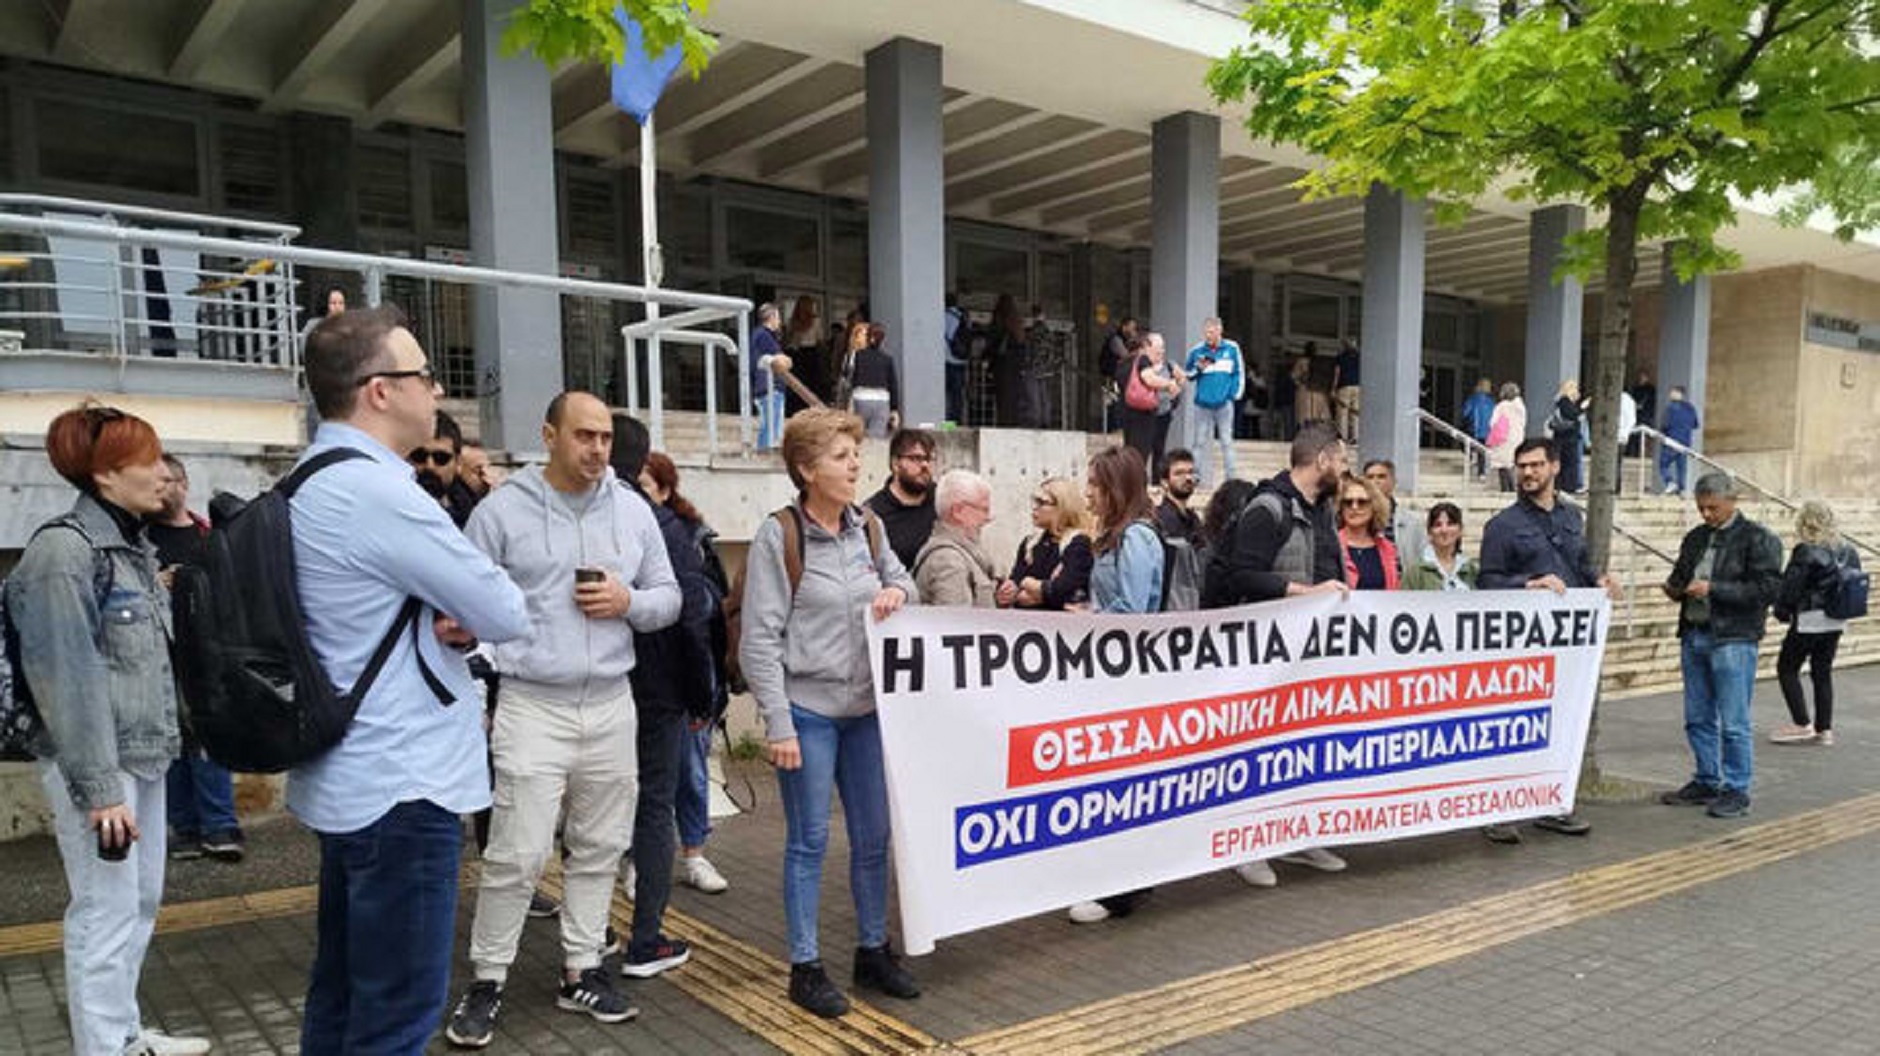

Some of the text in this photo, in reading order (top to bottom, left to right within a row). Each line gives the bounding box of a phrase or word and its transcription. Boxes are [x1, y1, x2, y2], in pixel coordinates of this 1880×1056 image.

[883, 608, 1598, 693] Η ΤΡΟΜΟΚΡΑΤΙΑ ΔΕΝ ΘΑ ΠΕΡΑΣΕΙ
[1033, 661, 1552, 771] ΘΕΣΣΑΛΟΝΙΚΗ ΛΙΜΑΝΙ ΤΩΝ ΛΑΩΝ,
[959, 712, 1549, 855] ΟΧΙ ΟΡΜΗΤΗΡΙΟ ΤΩΝ ΙΜΠΕΡΙΑΛΙΣΤΩΝ
[1211, 815, 1312, 859] ΕΡΓΑΤΙΚΑ
[1317, 806, 1432, 836] ΣΩΜΑΤΕΙΑ
